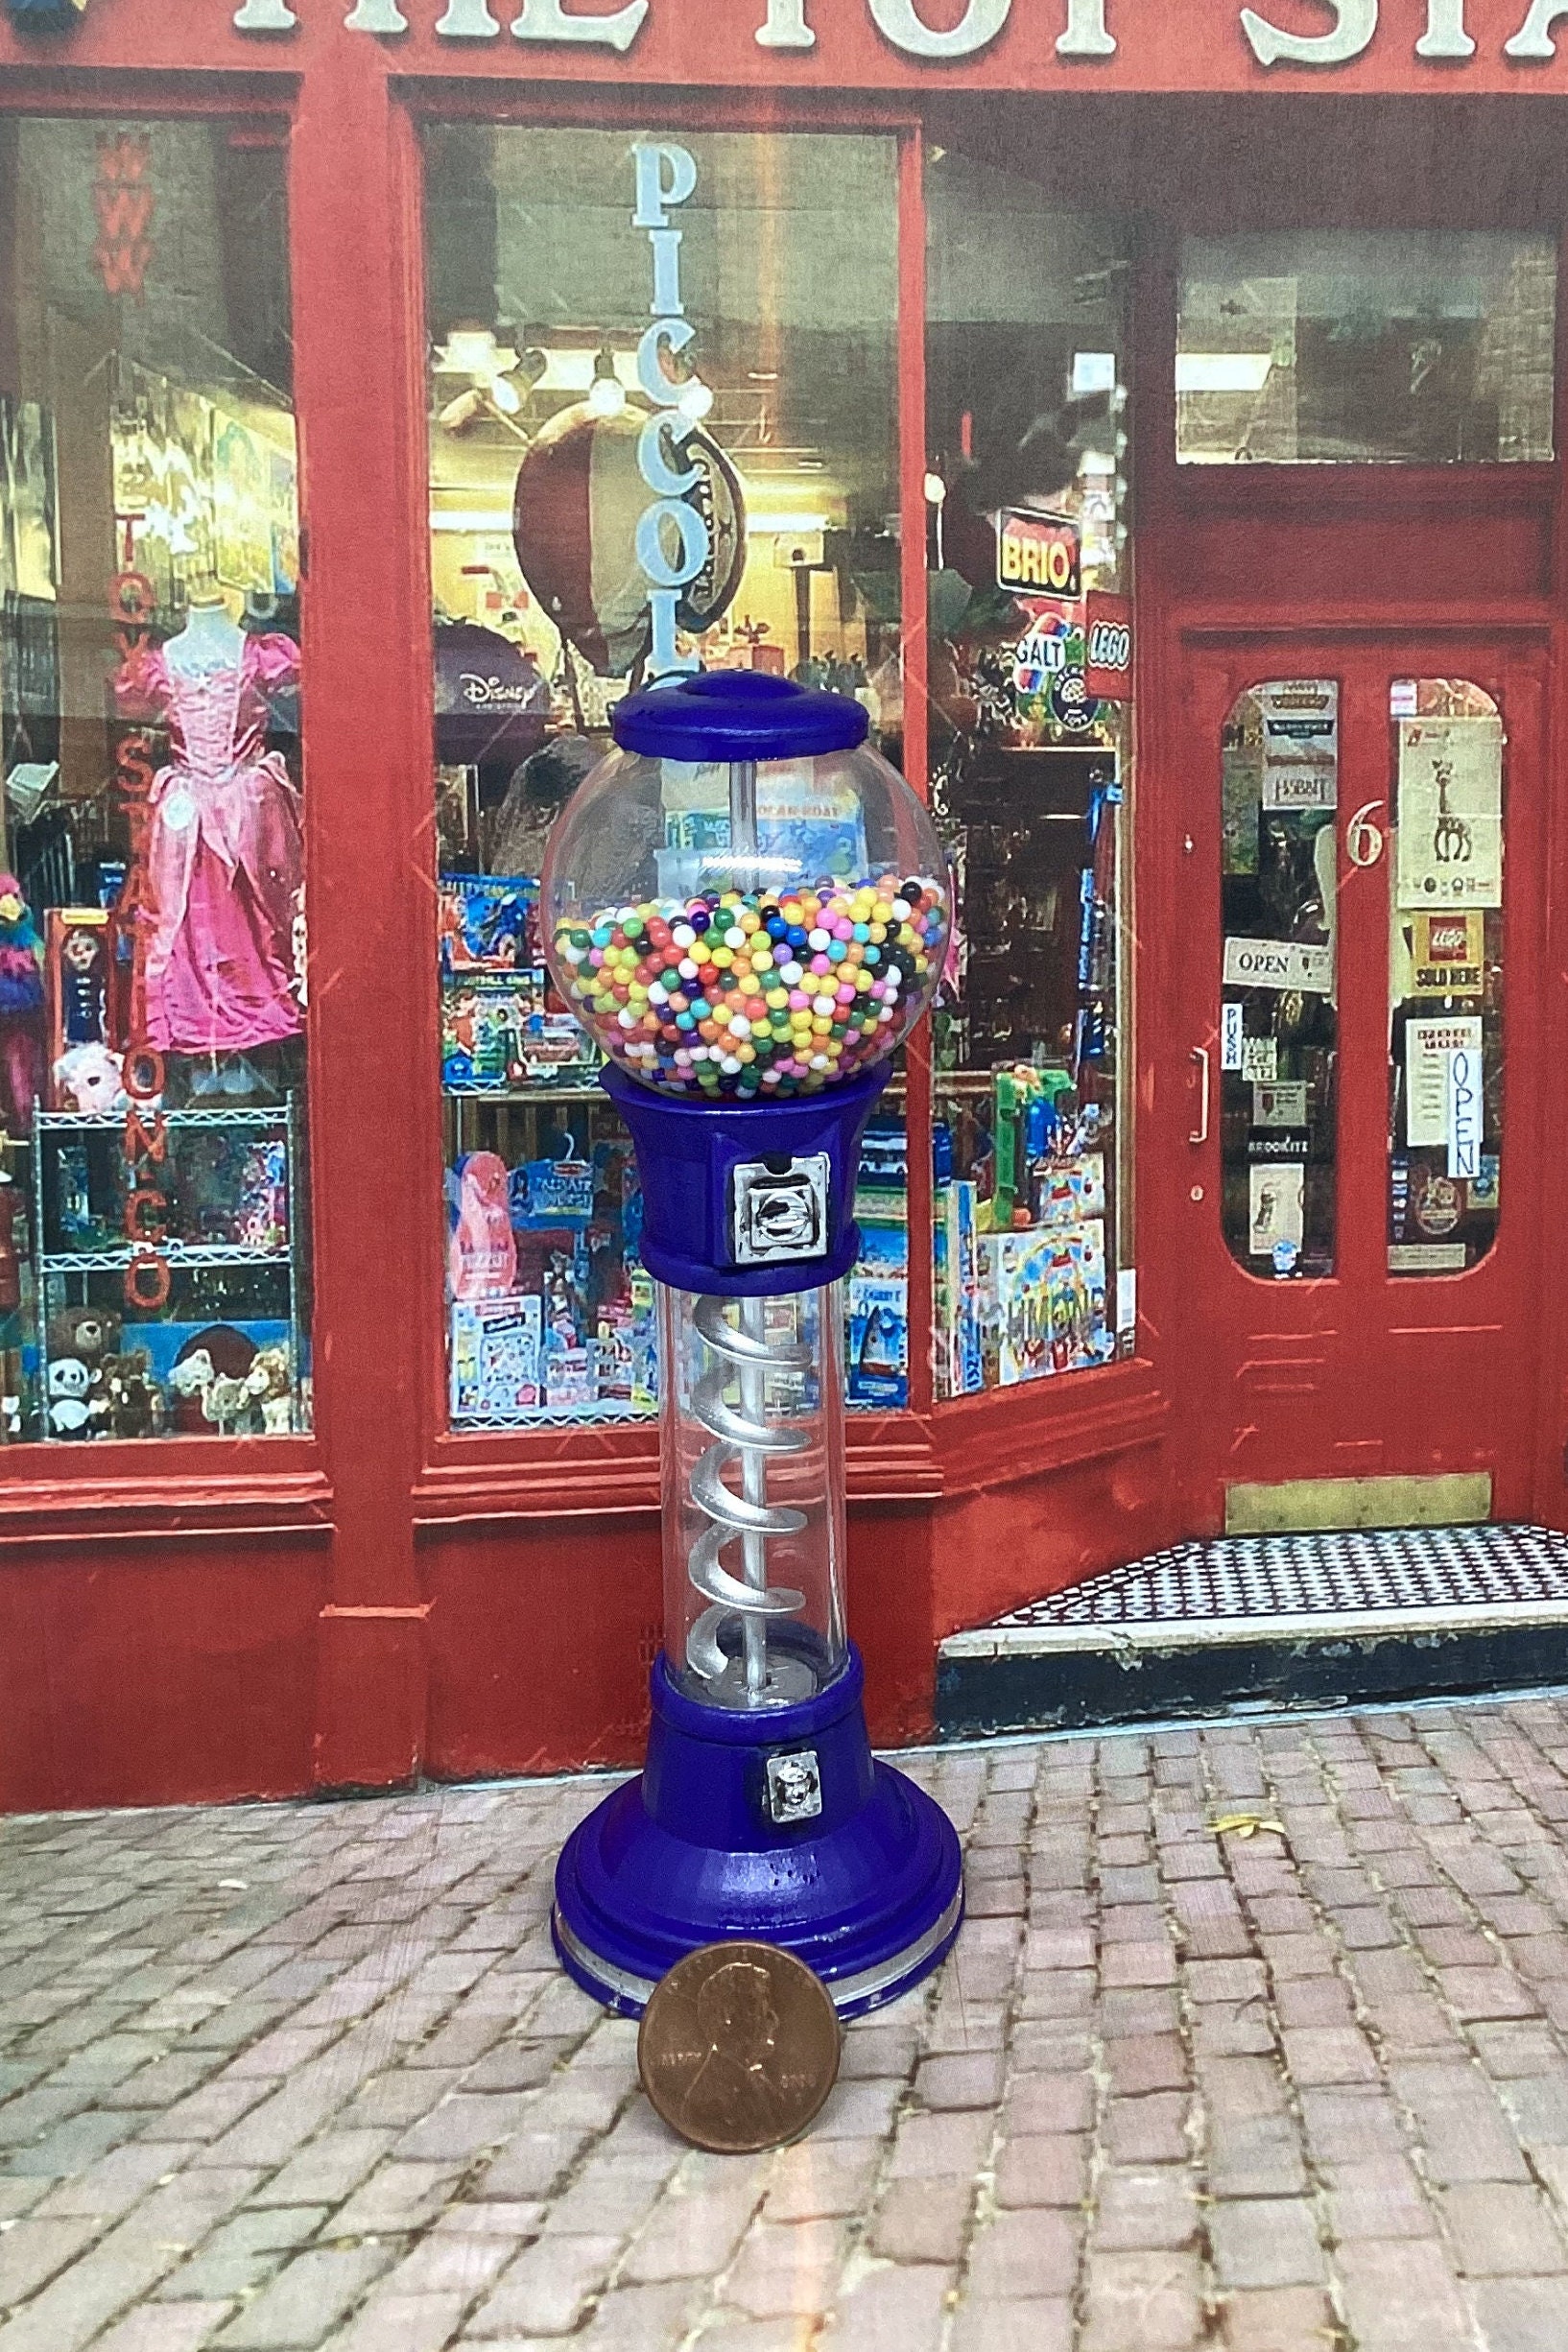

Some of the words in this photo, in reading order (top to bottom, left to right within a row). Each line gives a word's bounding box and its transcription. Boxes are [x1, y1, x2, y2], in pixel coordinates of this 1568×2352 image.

[631, 143, 711, 690] PICCOL
[1002, 534, 1069, 588] BRIO
[1016, 639, 1061, 667] GALT
[1090, 626, 1128, 667] LEGO
[1346, 800, 1383, 866] 6
[1239, 953, 1290, 974] OPEN
[1226, 1009, 1237, 1065] PUSH
[1453, 1052, 1474, 1176] OPEN
